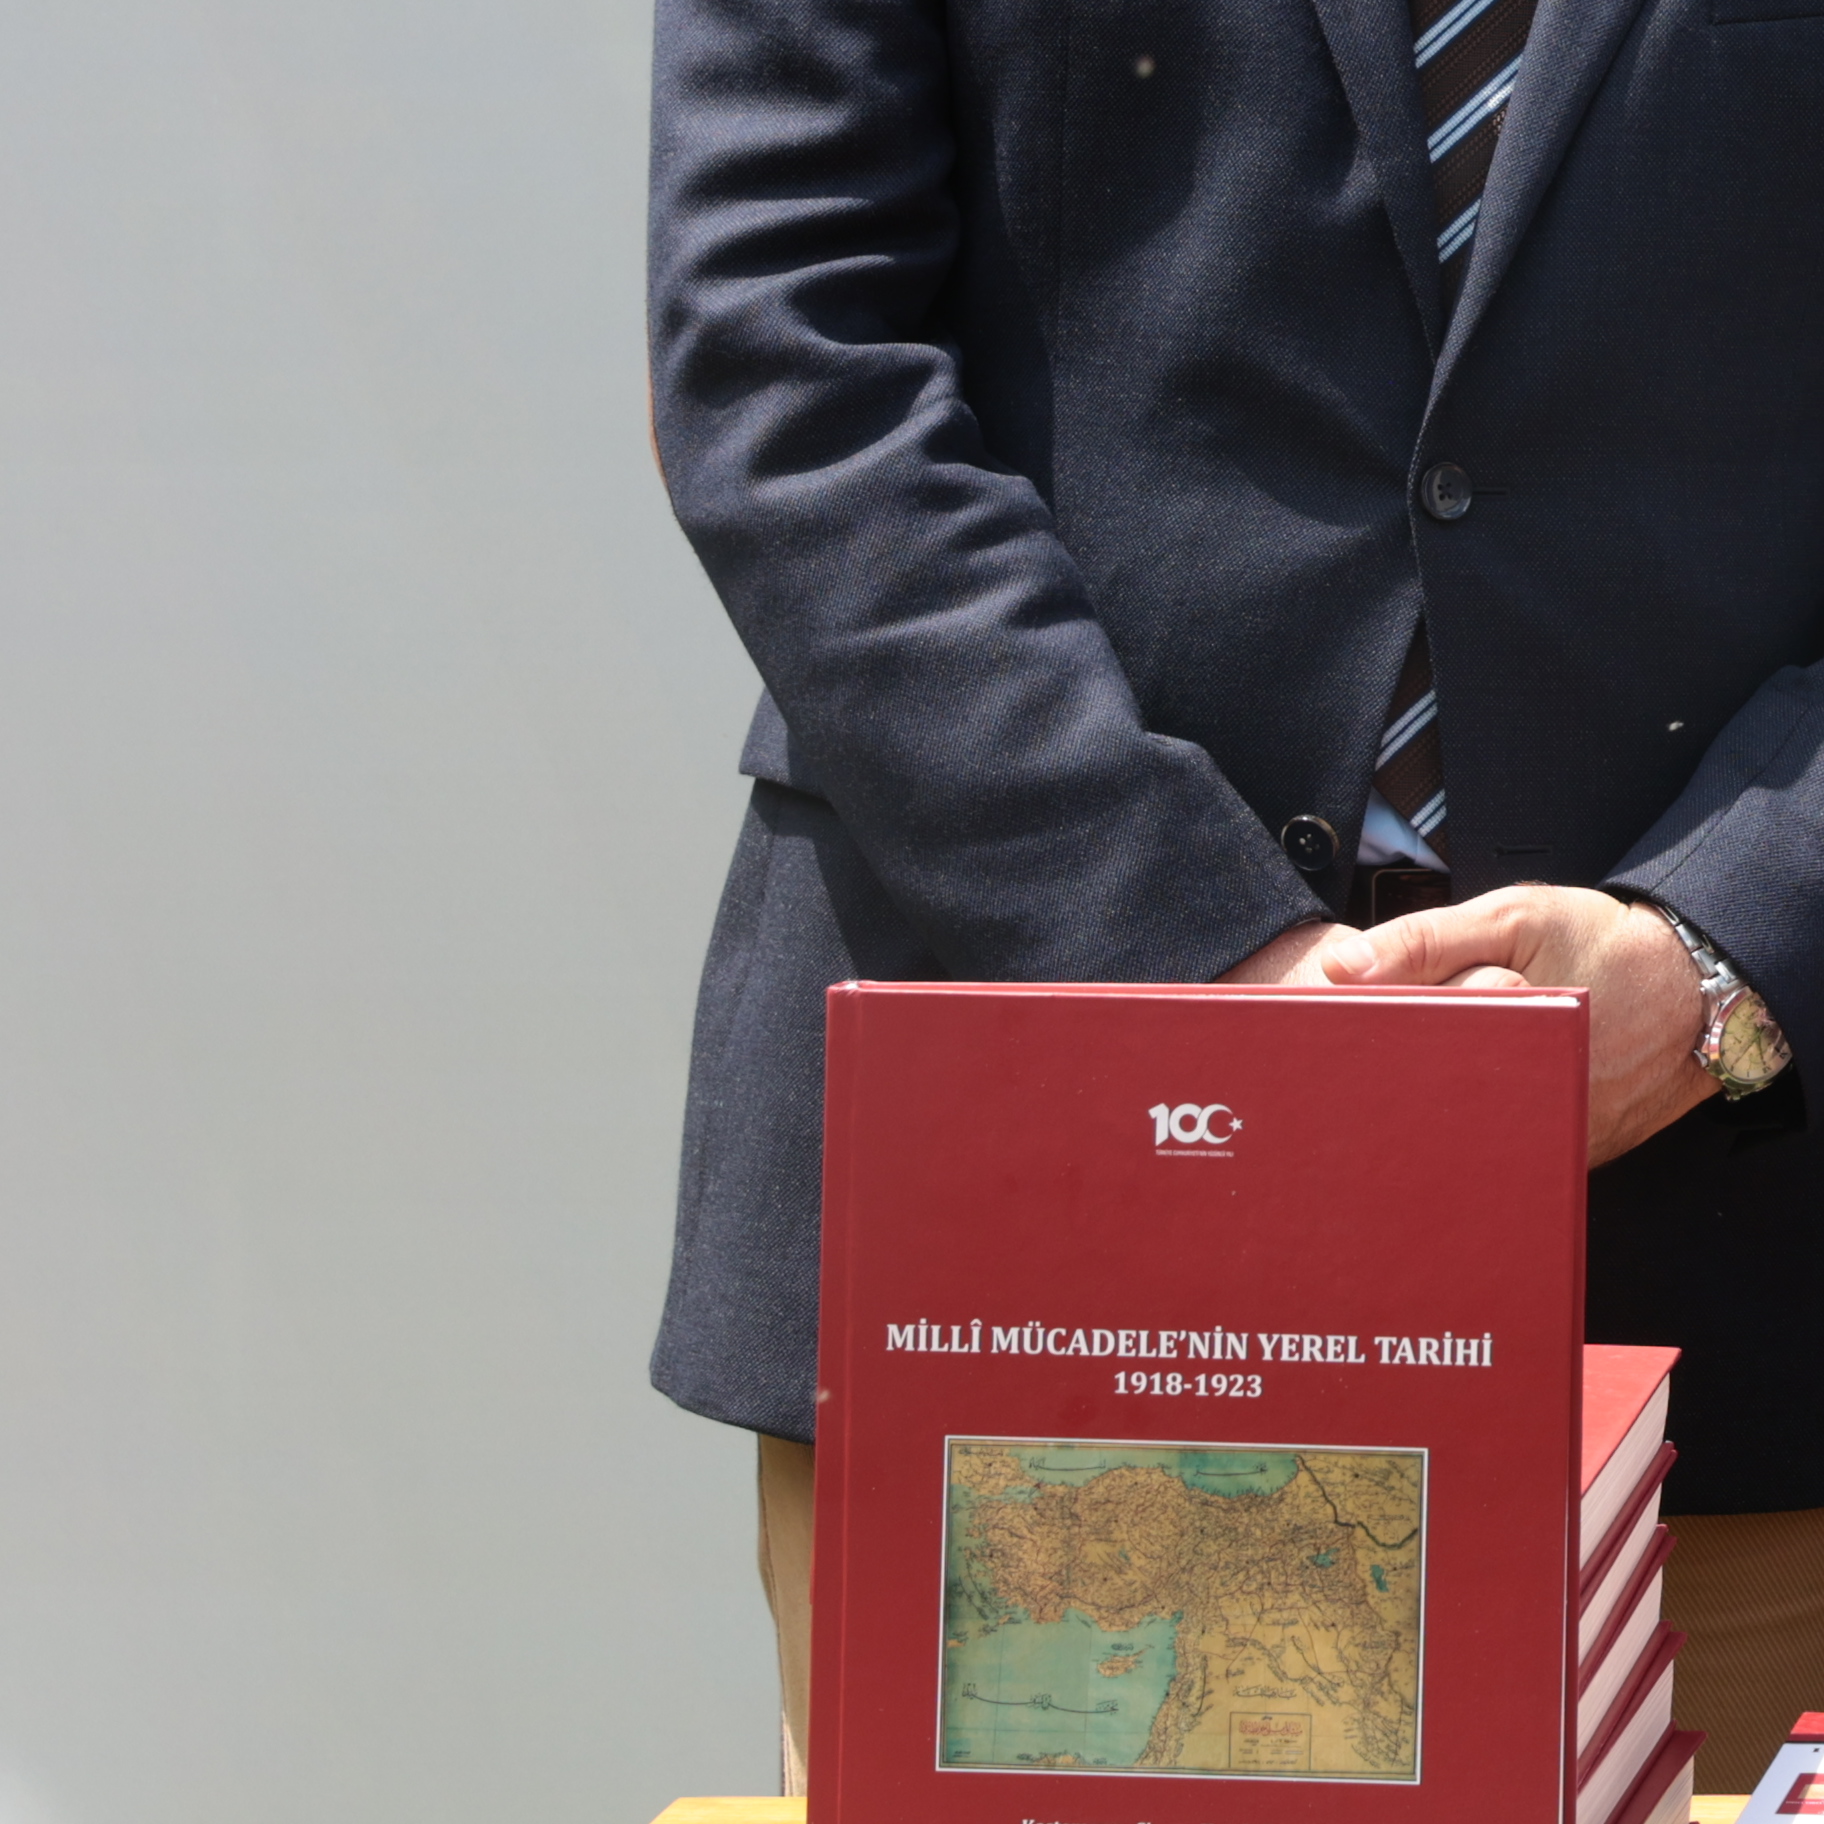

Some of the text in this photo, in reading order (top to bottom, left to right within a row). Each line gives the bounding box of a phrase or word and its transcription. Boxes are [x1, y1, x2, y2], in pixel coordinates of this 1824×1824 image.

[886, 1318, 982, 1353] MİLLÎ
[1257, 1333, 1366, 1363] YEREL
[1374, 1331, 1493, 1367] TARİHİ
[1114, 1371, 1262, 1398] 1918-1923
